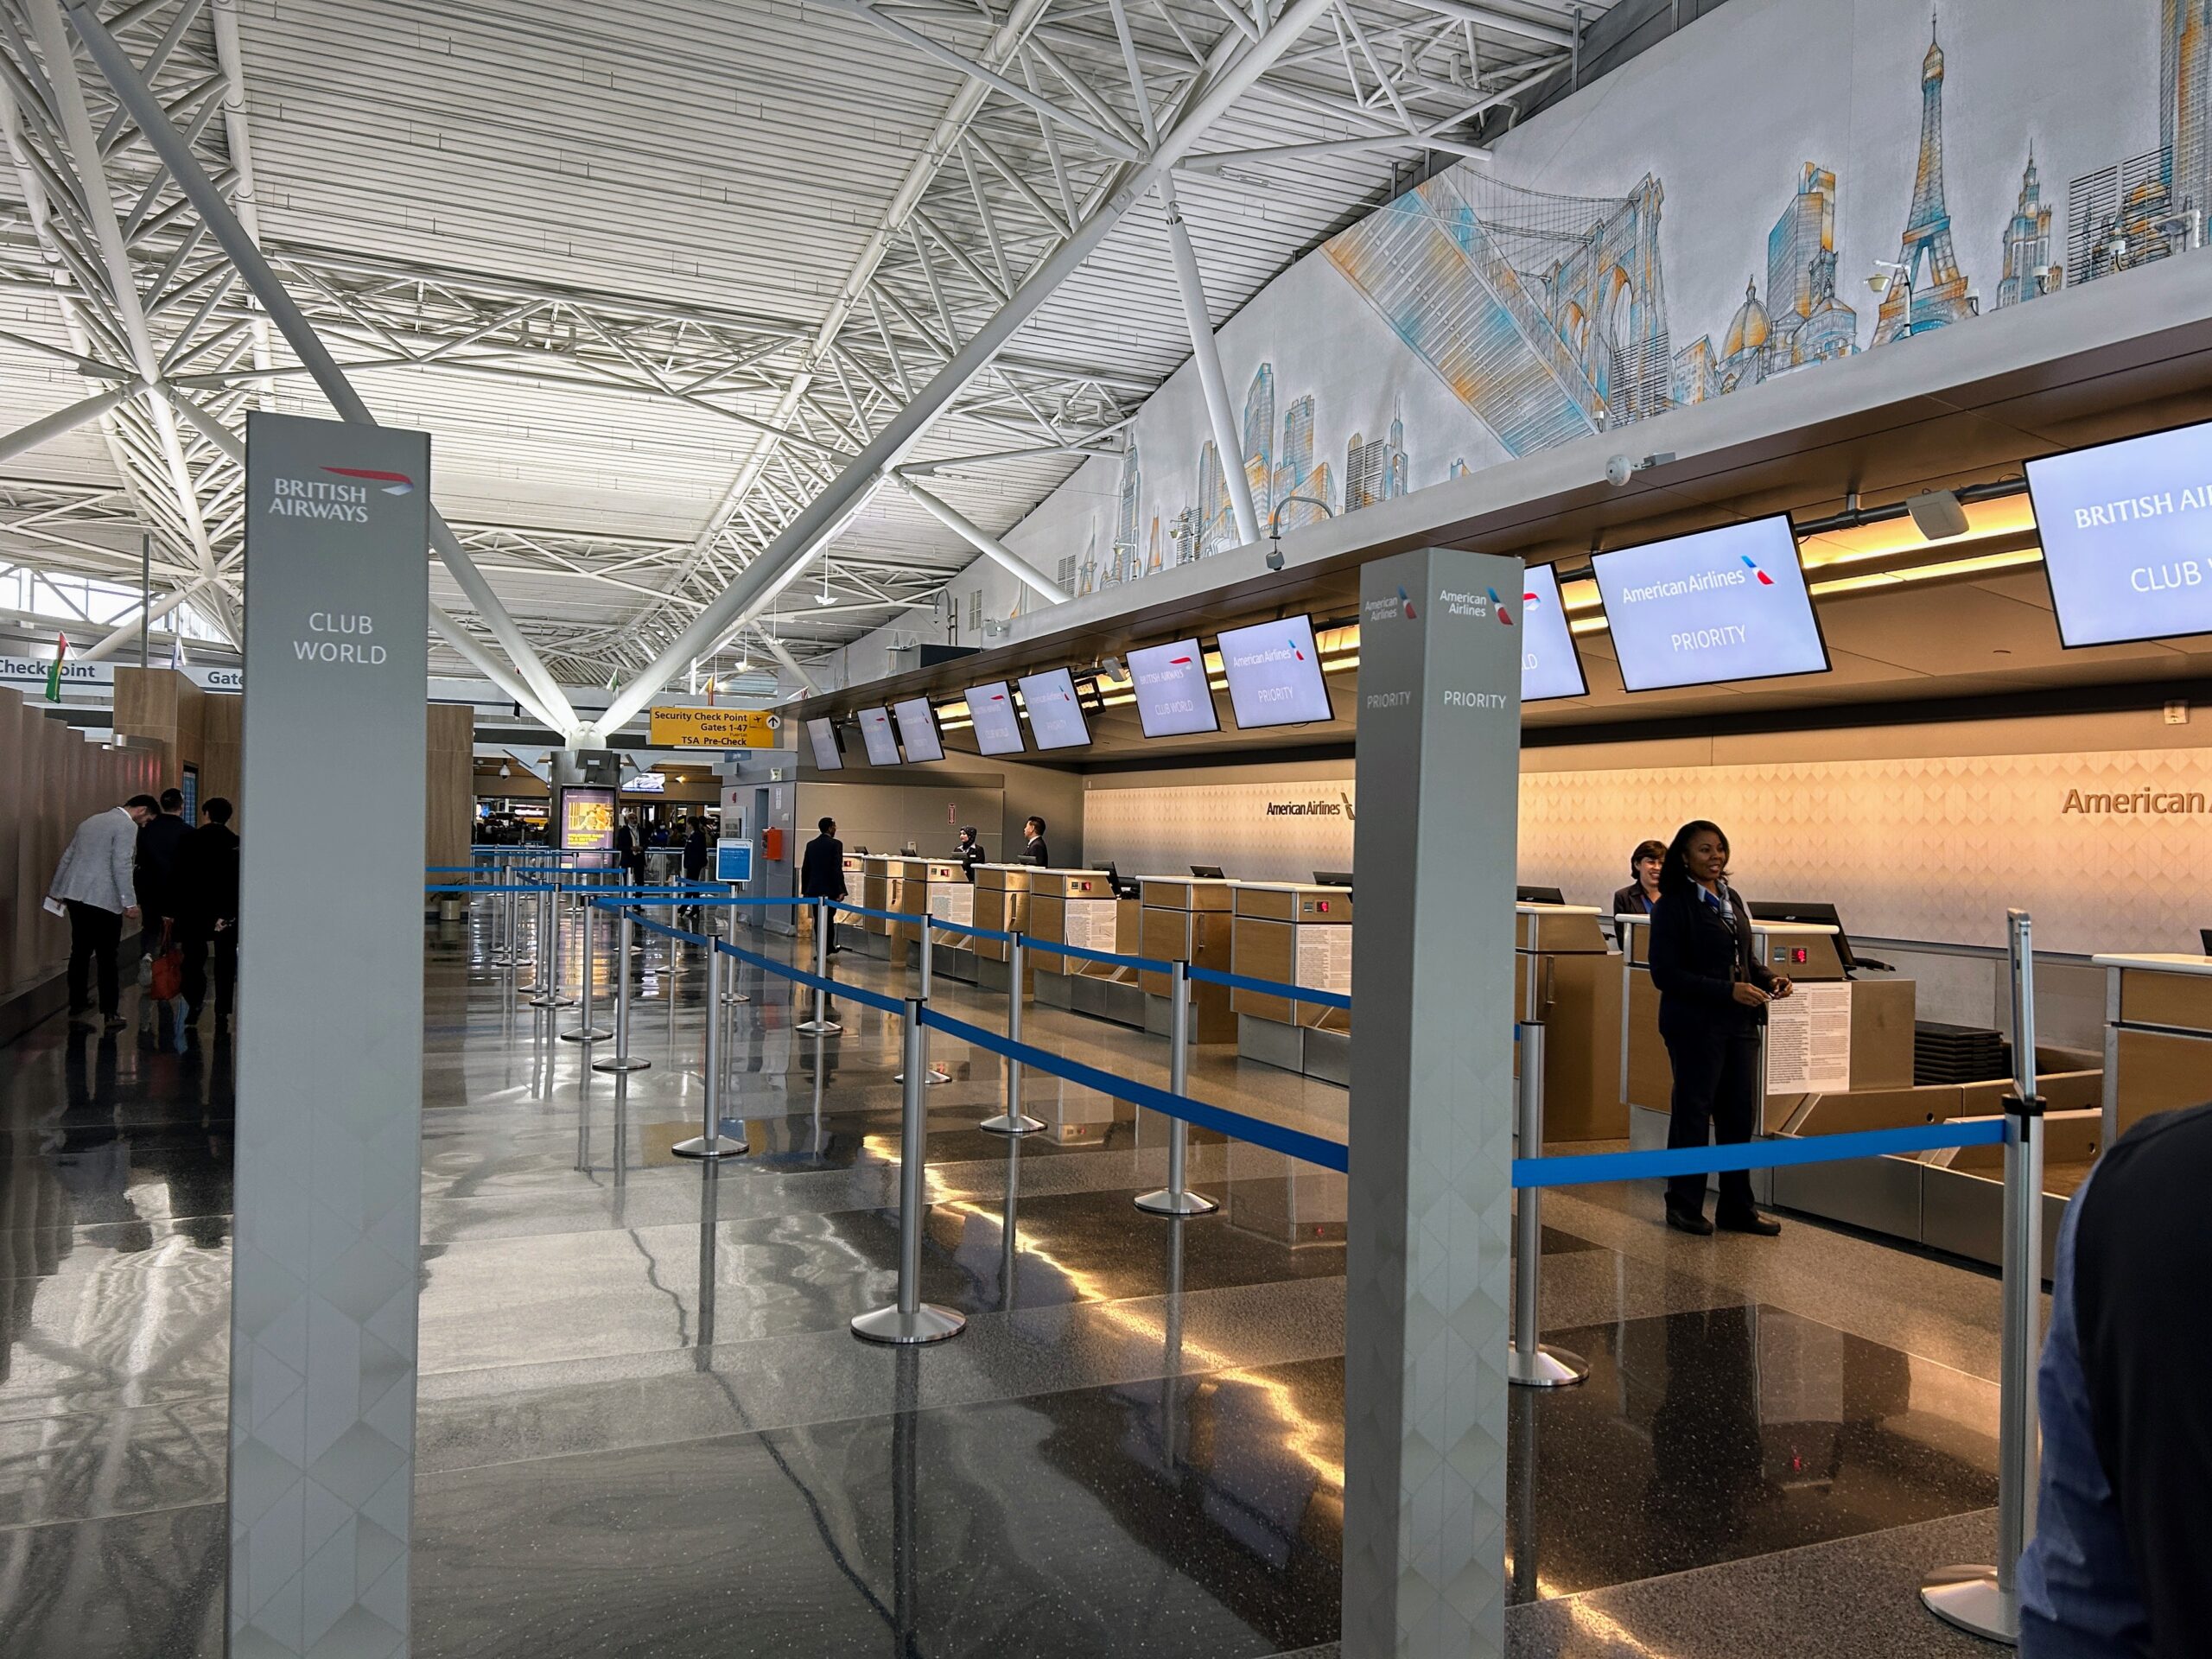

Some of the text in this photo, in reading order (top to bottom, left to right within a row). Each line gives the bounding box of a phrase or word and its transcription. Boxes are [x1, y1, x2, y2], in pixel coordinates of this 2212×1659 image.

[275, 478, 366, 503] BRITISH
[269, 498, 368, 523] AIRWAYS
[2074, 492, 2173, 529] BRITISH
[2131, 560, 2202, 592] CLUB
[1623, 569, 1746, 604] American Airlines
[1365, 595, 1398, 612] American
[1440, 589, 1487, 605] American
[1370, 607, 1397, 621] Airlines
[1448, 603, 1486, 617] Airlines
[309, 612, 372, 634] CLUB
[1671, 624, 1746, 652] PRIORITY
[293, 640, 387, 664] WORLD
[1233, 648, 1291, 668] American Airlines
[1139, 672, 1160, 684] BRITISH
[1258, 686, 1294, 703] PRIORITY
[1367, 690, 1411, 709] PRIORITY
[1444, 690, 1506, 709] PRIORITY
[655, 711, 747, 721] Security Check Point
[1154, 700, 1193, 715] CLUB WORLD
[701, 722, 727, 732] Gates
[703, 737, 747, 746] Pre-Check
[1267, 801, 1340, 815] American Airlines
[2062, 786, 2205, 814] American
